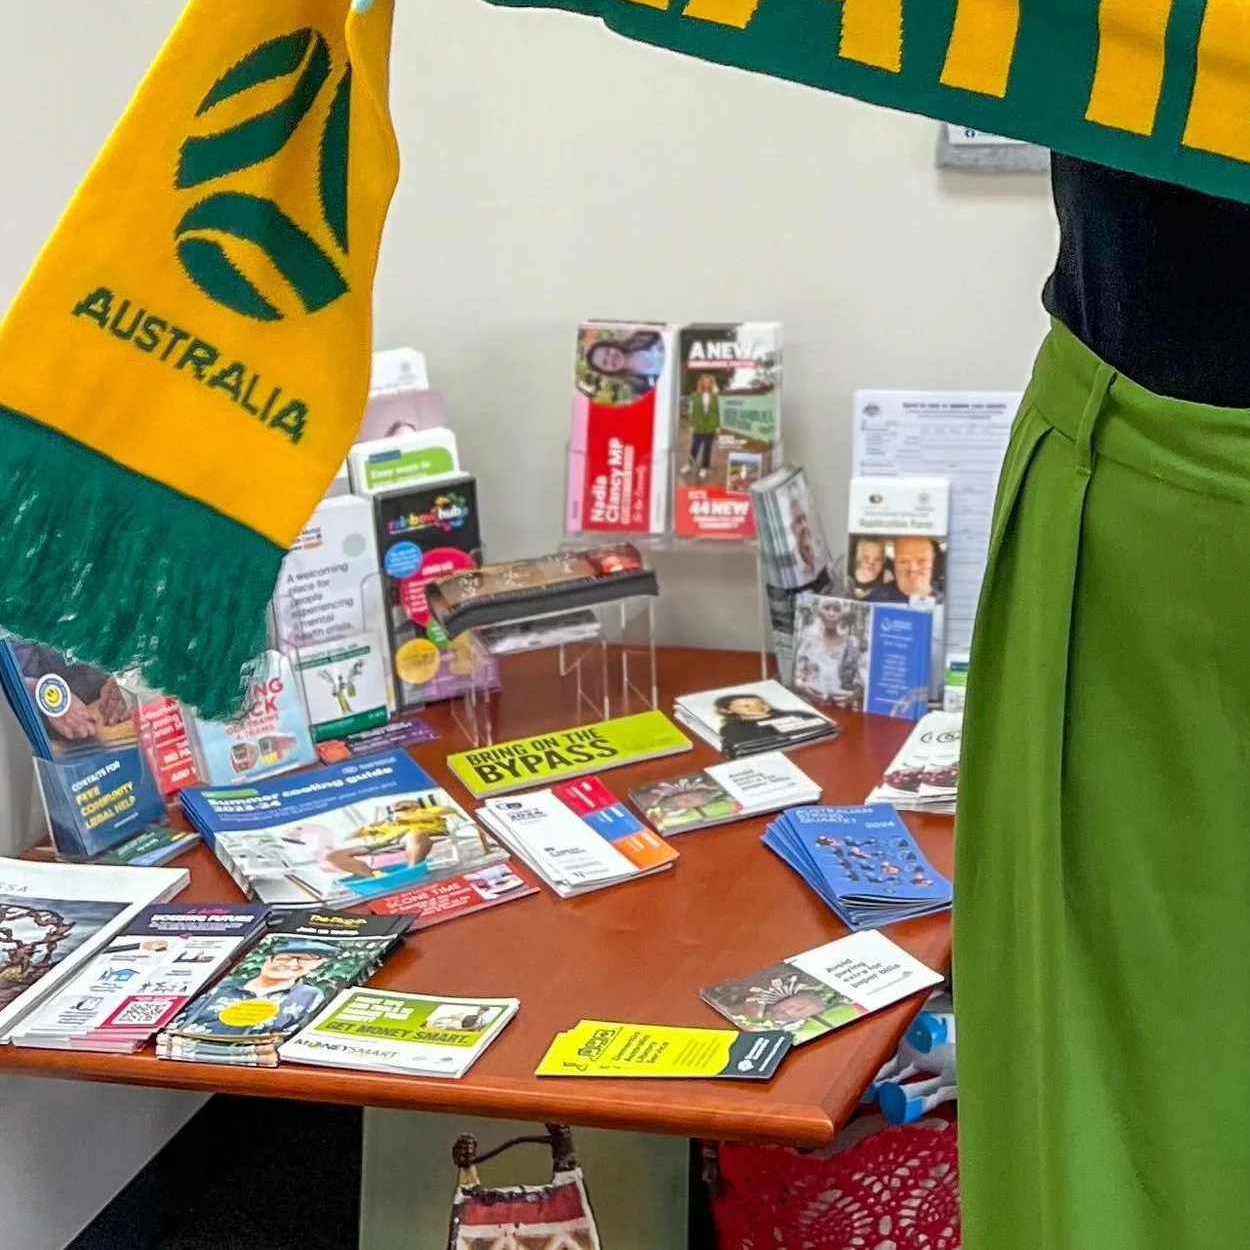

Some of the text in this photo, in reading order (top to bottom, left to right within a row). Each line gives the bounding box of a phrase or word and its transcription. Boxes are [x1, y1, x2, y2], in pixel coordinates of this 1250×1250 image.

[688, 341, 755, 360] A NEW
[70, 286, 311, 446] AUSTRALIA
[605, 437, 625, 523] Clancy MP
[590, 476, 607, 522] Nadia
[689, 501, 749, 517] 44 NEW
[286, 562, 349, 584] A welcoming
[288, 578, 330, 596] place for
[291, 597, 354, 619] experiencing
[301, 613, 335, 628] mental
[466, 728, 605, 766] BRING ON THE
[475, 738, 620, 784] BYPASS
[71, 760, 121, 792] CONTACTS FOR
[207, 766, 393, 806] Summer cooling guide
[80, 781, 134, 816] COMMUNITY
[115, 796, 136, 814] HELP
[795, 808, 874, 816] AUSTRALIAN
[432, 882, 462, 896] TIME
[825, 958, 852, 973] Avoid
[834, 962, 867, 978] paying
[843, 970, 868, 982] extra
[851, 964, 900, 988] paper bills
[325, 1022, 469, 1044] GET MONEY SMART.
[294, 1038, 399, 1059] MONEYSMART
